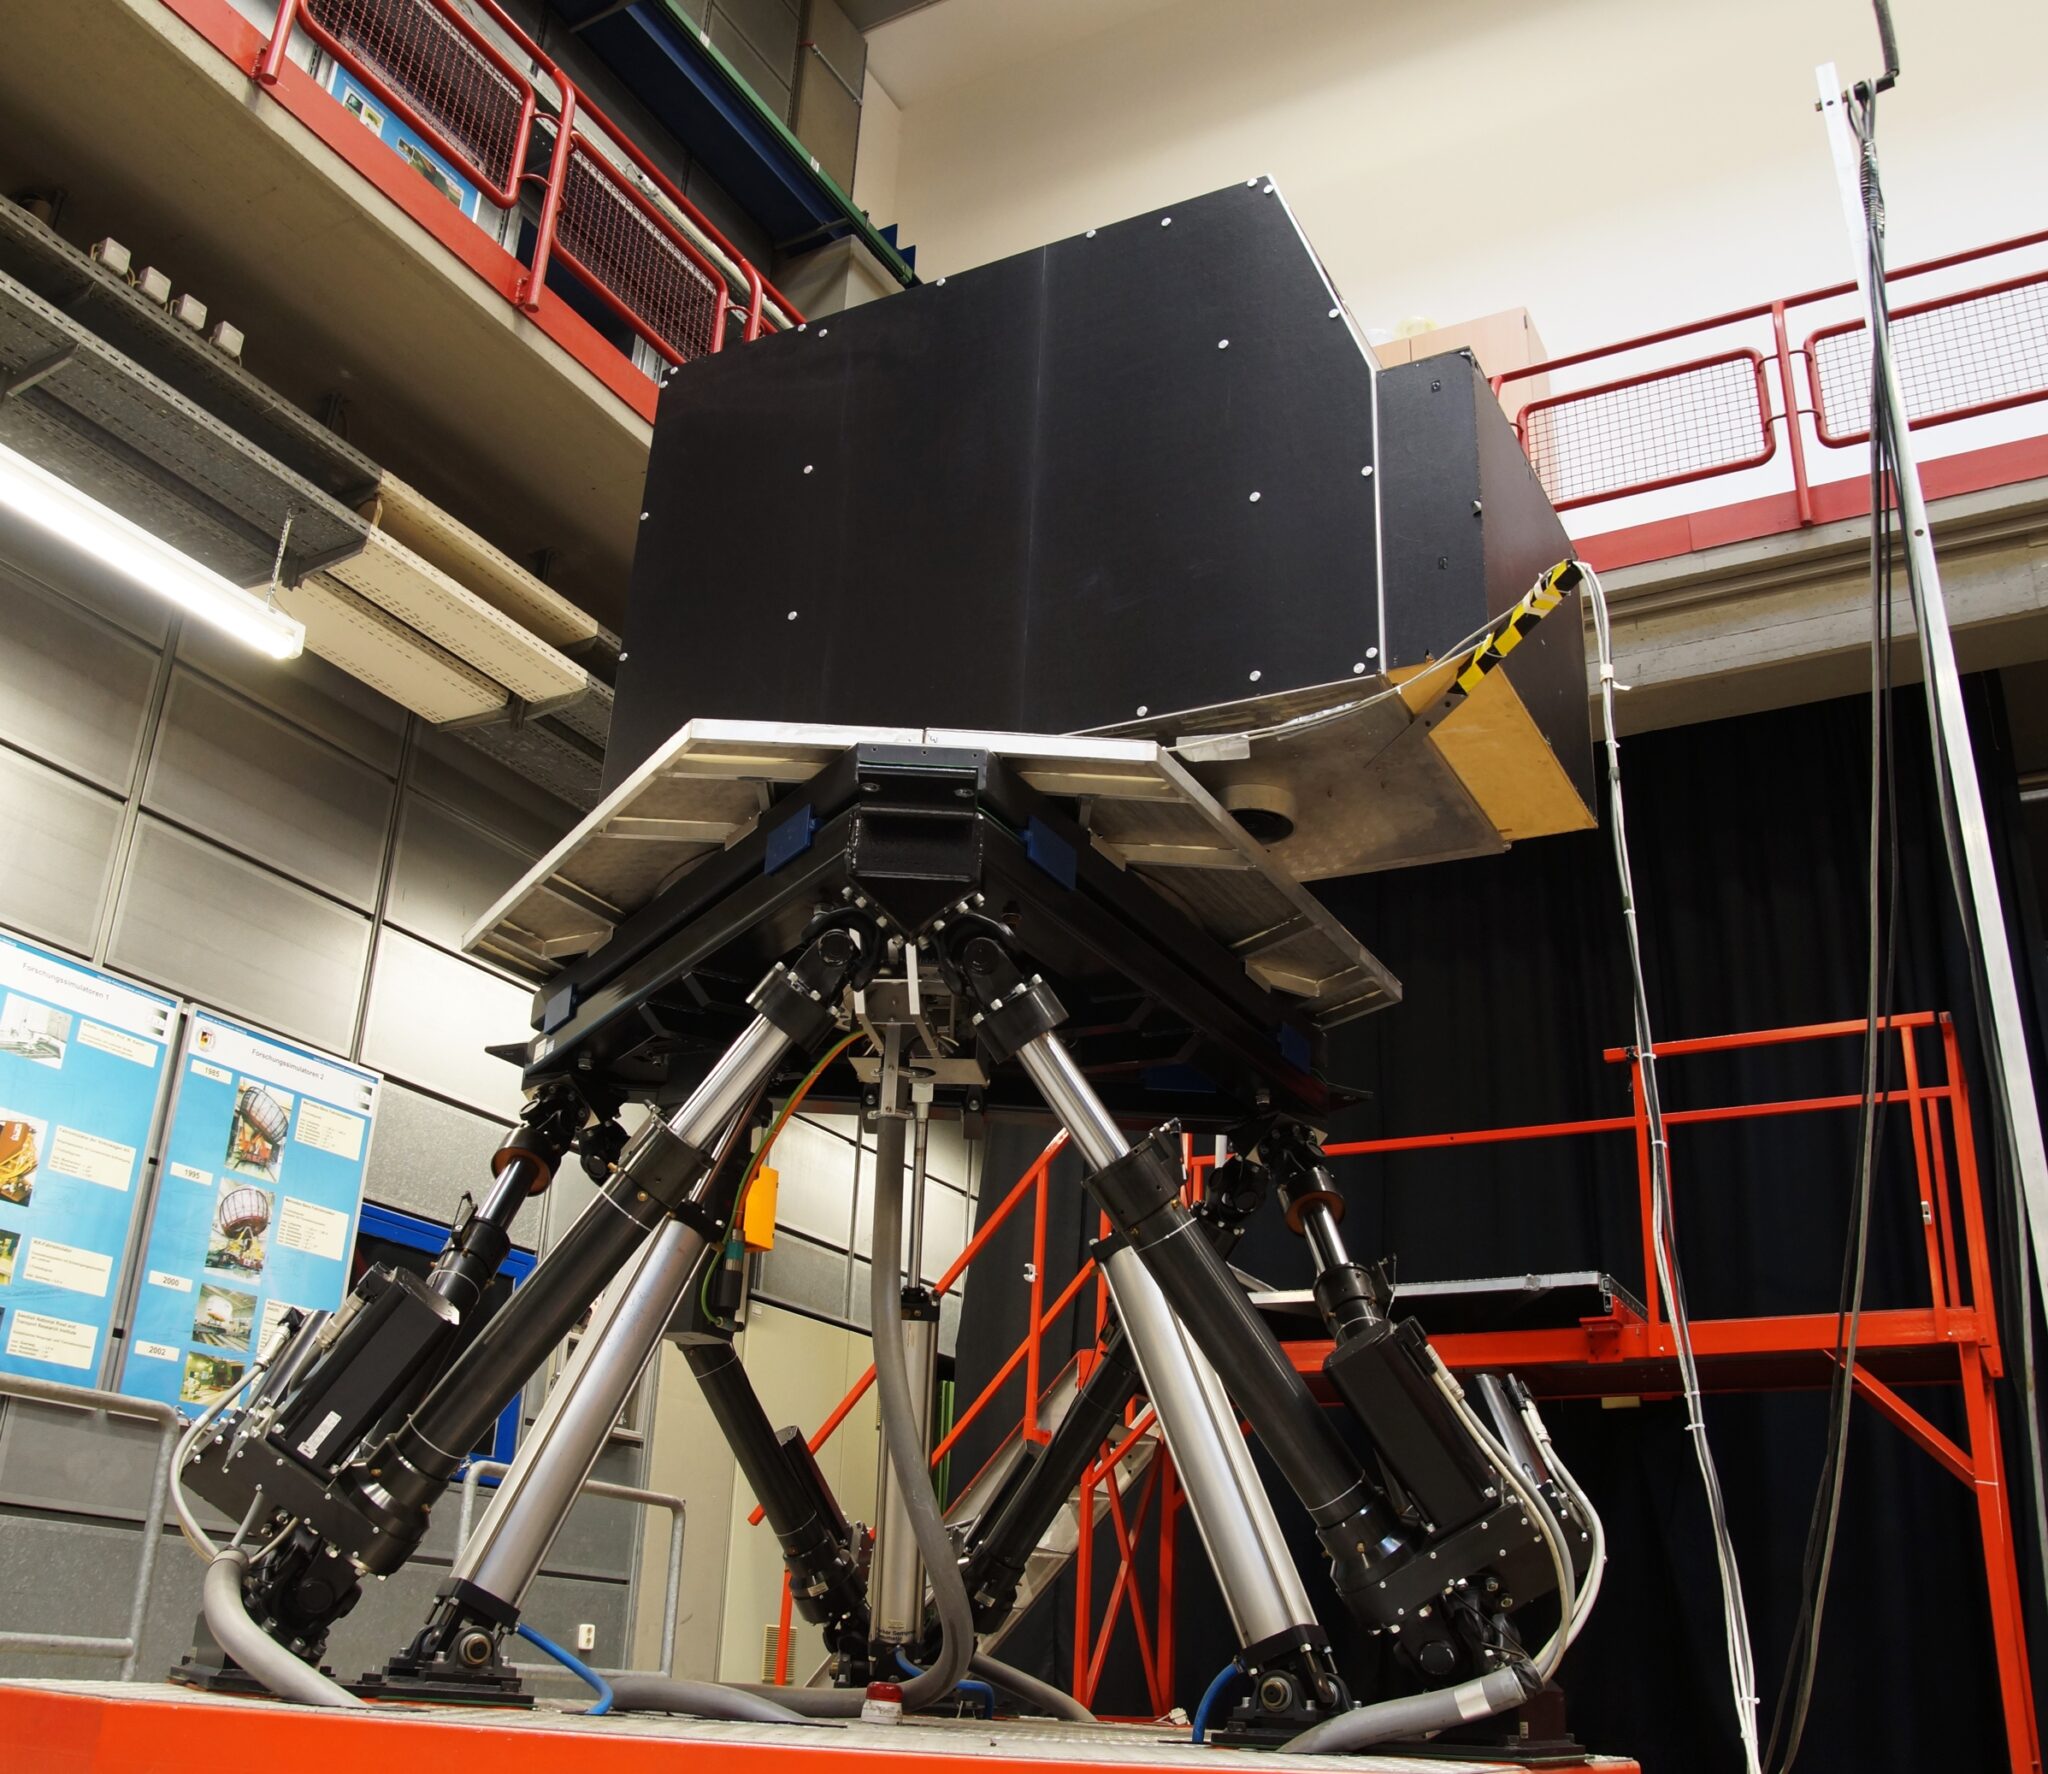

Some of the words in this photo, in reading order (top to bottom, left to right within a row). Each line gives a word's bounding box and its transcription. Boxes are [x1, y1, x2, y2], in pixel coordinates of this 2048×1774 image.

[22, 962, 104, 999] Forschungssimulatoren
[251, 1048, 319, 1078] Forschungssimulatoren
[185, 1168, 200, 1179] 1995
[162, 1276, 180, 1287] 2000
[148, 1345, 166, 1356] 2002
